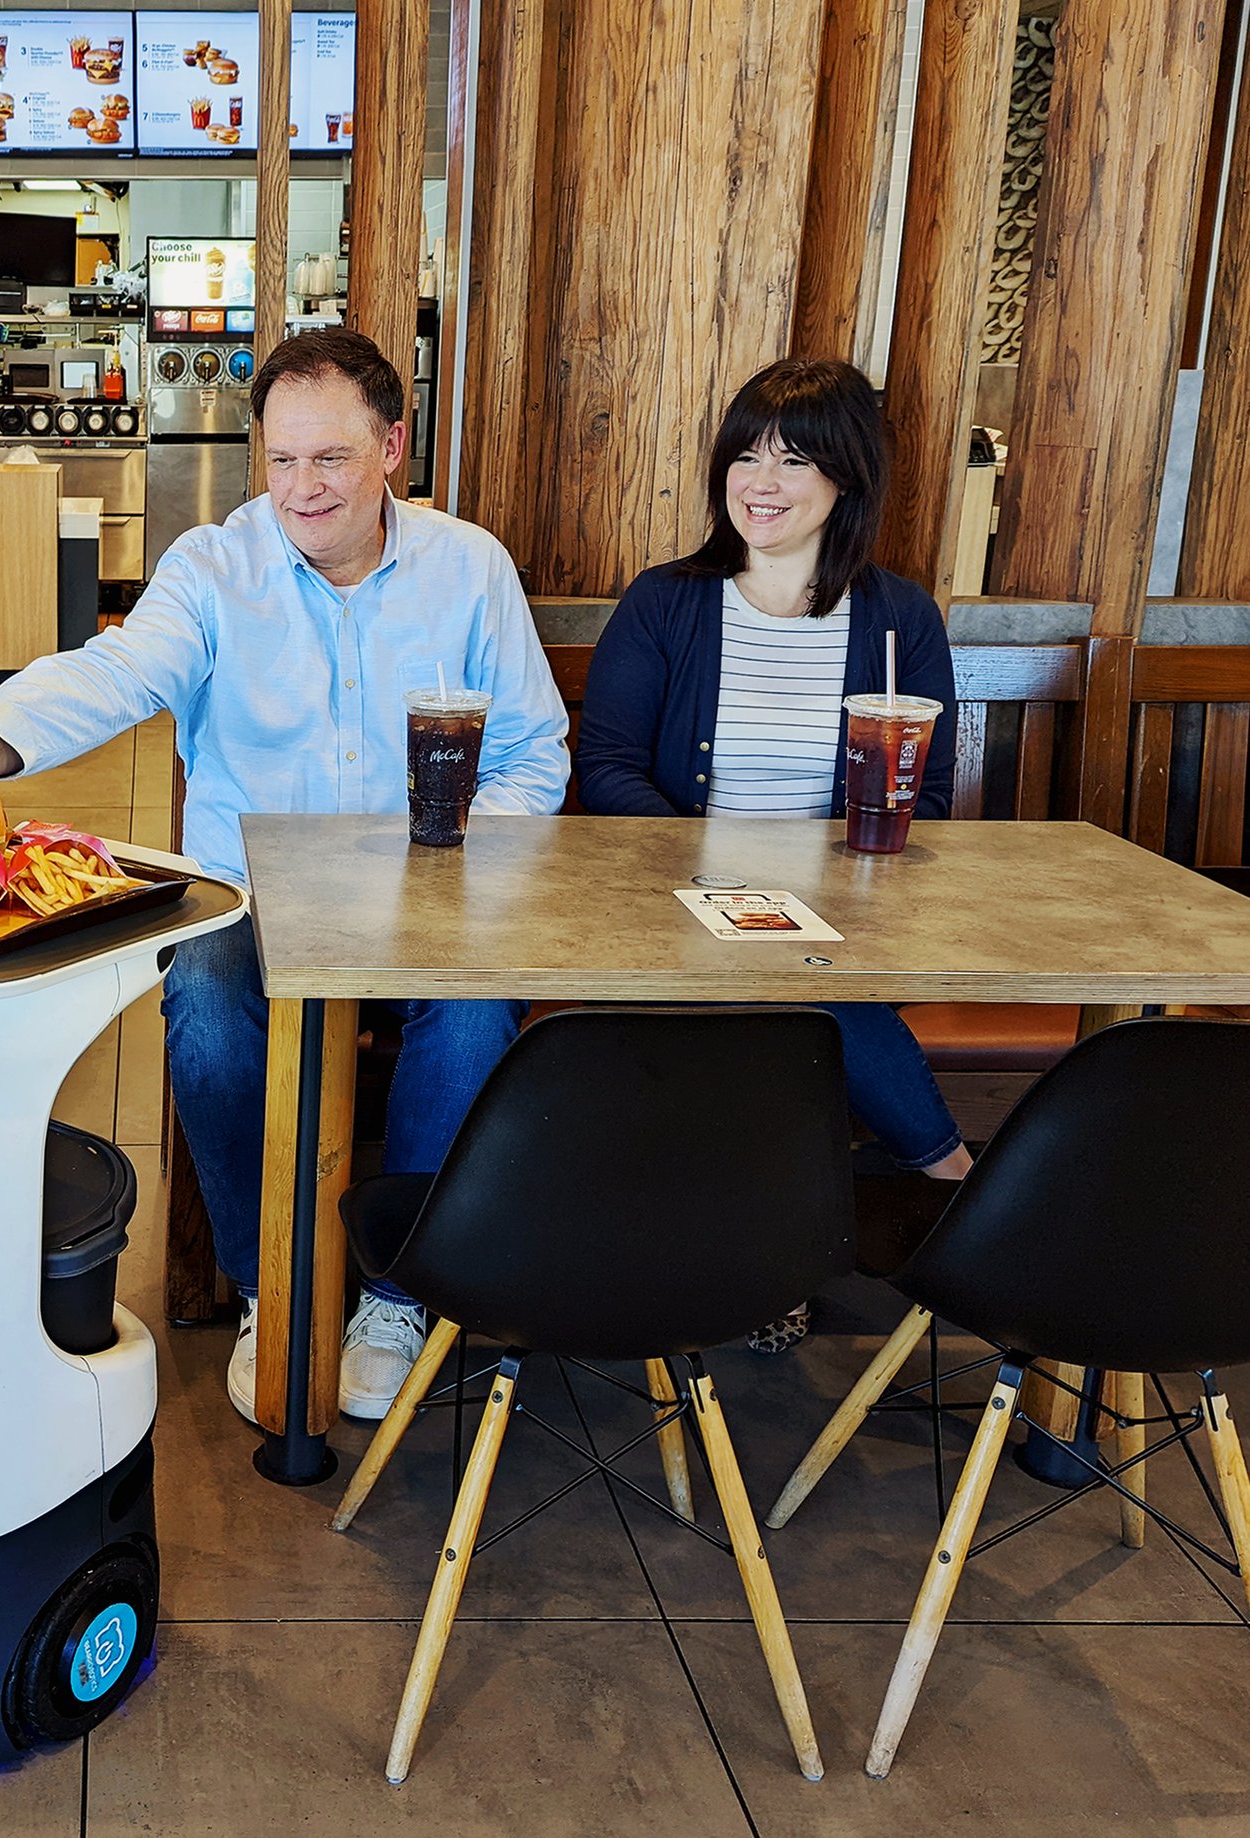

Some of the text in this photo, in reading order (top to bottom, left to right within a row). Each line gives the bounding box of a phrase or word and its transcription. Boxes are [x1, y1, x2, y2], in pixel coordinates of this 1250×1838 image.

[317, 19, 355, 28] Beverage
[21, 46, 27, 55] 3
[142, 43, 148, 52] 5
[142, 60, 148, 68] 6
[22, 96, 28, 104] 4
[143, 112, 149, 120] 7
[152, 242, 192, 252] Choose
[152, 252, 201, 265] your chill
[430, 746, 464, 763] McCafé
